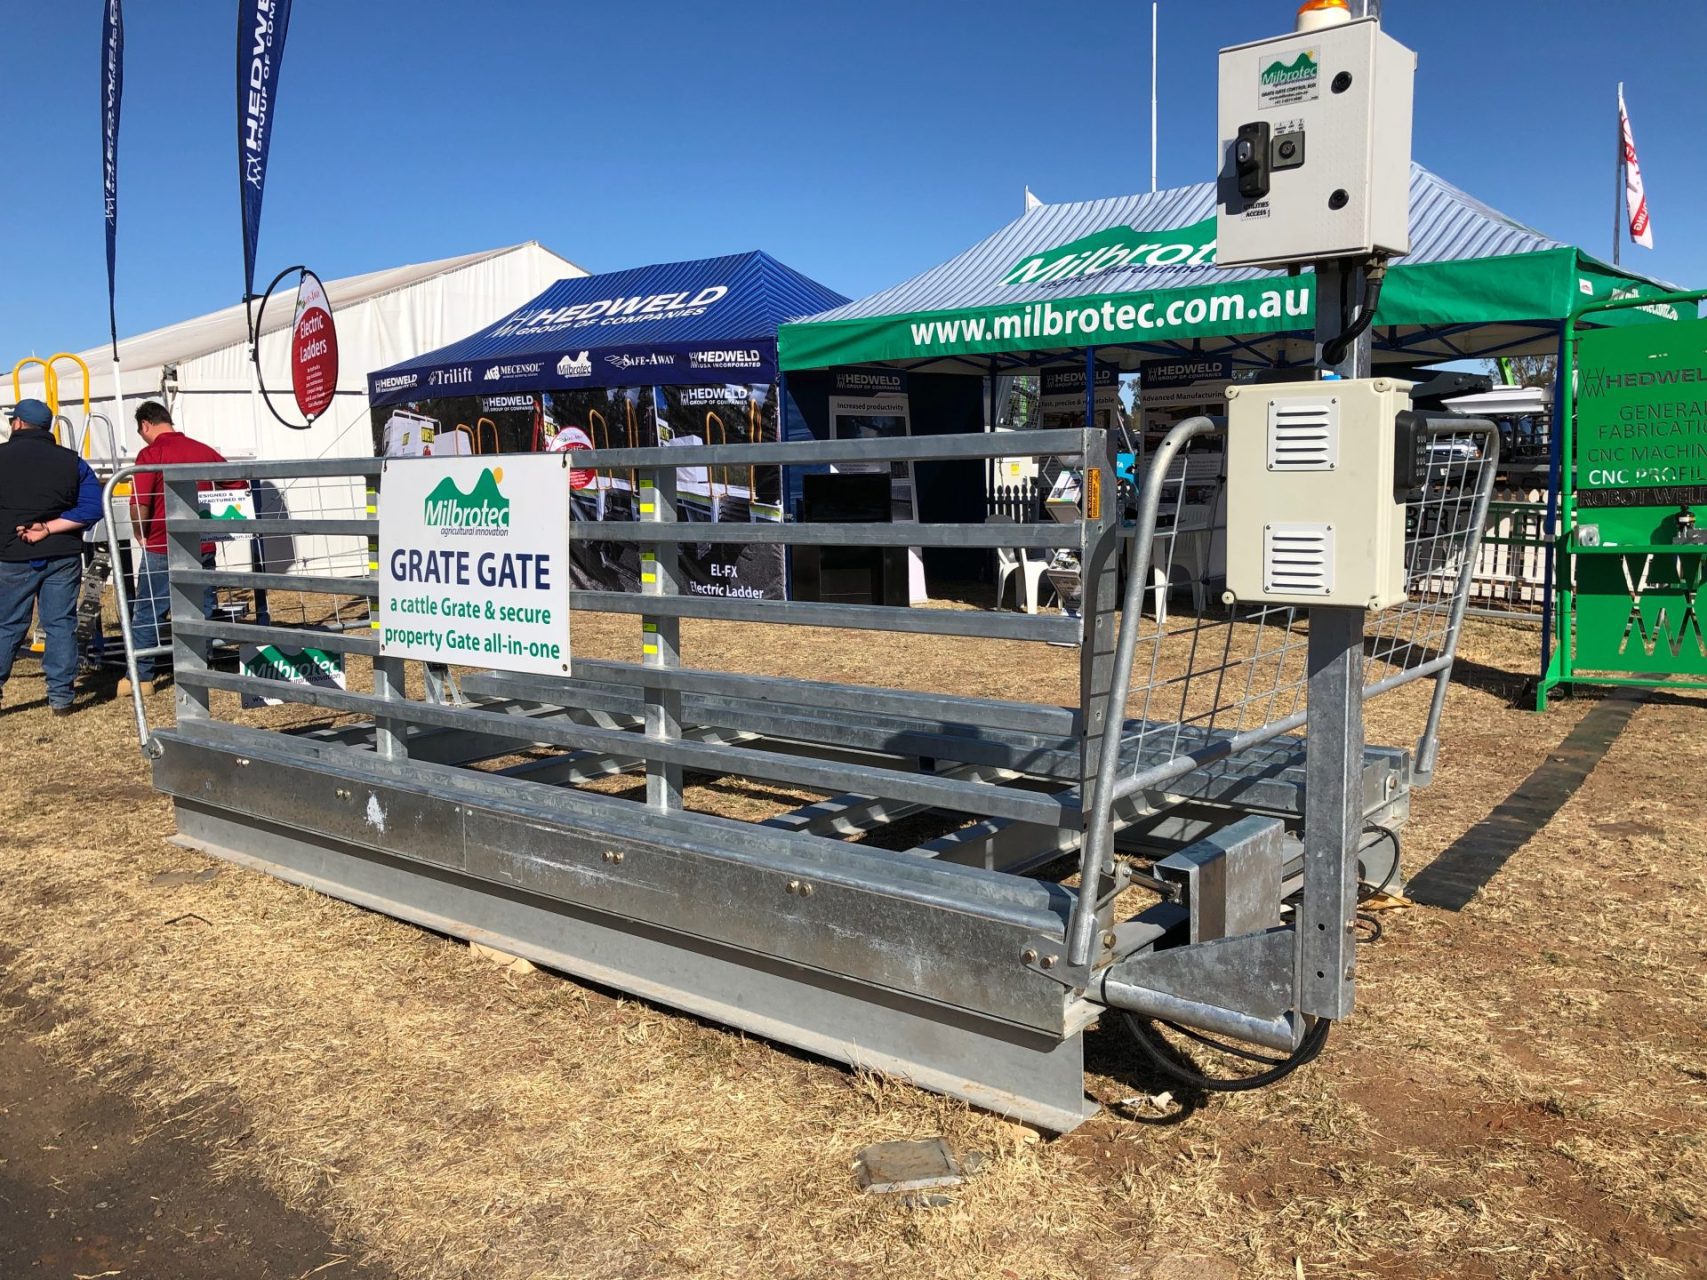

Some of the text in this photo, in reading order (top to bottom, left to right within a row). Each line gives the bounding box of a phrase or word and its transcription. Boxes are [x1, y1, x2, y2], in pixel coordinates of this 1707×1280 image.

[257, 0, 278, 152] GROUP OF COM
[1262, 66, 1317, 85] Milbrotec
[997, 239, 1217, 286] Milbrot
[1154, 264, 1217, 274] innov
[528, 285, 728, 326] HEDWELD
[300, 311, 324, 339] Electric
[516, 307, 707, 336] GROUP OF COMPANIES
[910, 288, 1309, 346] www.milbrotec.com.au
[300, 338, 327, 363] Ladders
[698, 350, 760, 362] HEDWELD
[435, 367, 472, 385] Trilift
[500, 363, 540, 375] MECENSOL
[558, 361, 592, 376] Milbrotec
[1055, 370, 1111, 383] HEDWLD
[1157, 362, 1223, 376] HEDWELD
[380, 374, 418, 388] HEDWELD
[846, 373, 901, 386] HEDWELD
[1605, 367, 1707, 389] HEDWEL
[489, 395, 534, 407] HEDWELD
[689, 387, 748, 400] HEDWELD
[1143, 393, 1175, 402] Advanced
[837, 402, 905, 412] Increased productivity
[1588, 448, 1624, 463] CNC
[1588, 465, 1707, 485] CNC PROFIL
[199, 491, 227, 499] ESIGNED
[1580, 489, 1650, 507] ROBOT
[425, 499, 509, 528] Milbrotec
[441, 526, 509, 538] agricultural innovation
[391, 548, 551, 590] GRATE GATE
[710, 563, 738, 578] EL-FX
[689, 581, 764, 599] Electric Ladder
[390, 596, 551, 624] a cattle Grate & secure
[385, 627, 560, 659] property Gate all-in-one
